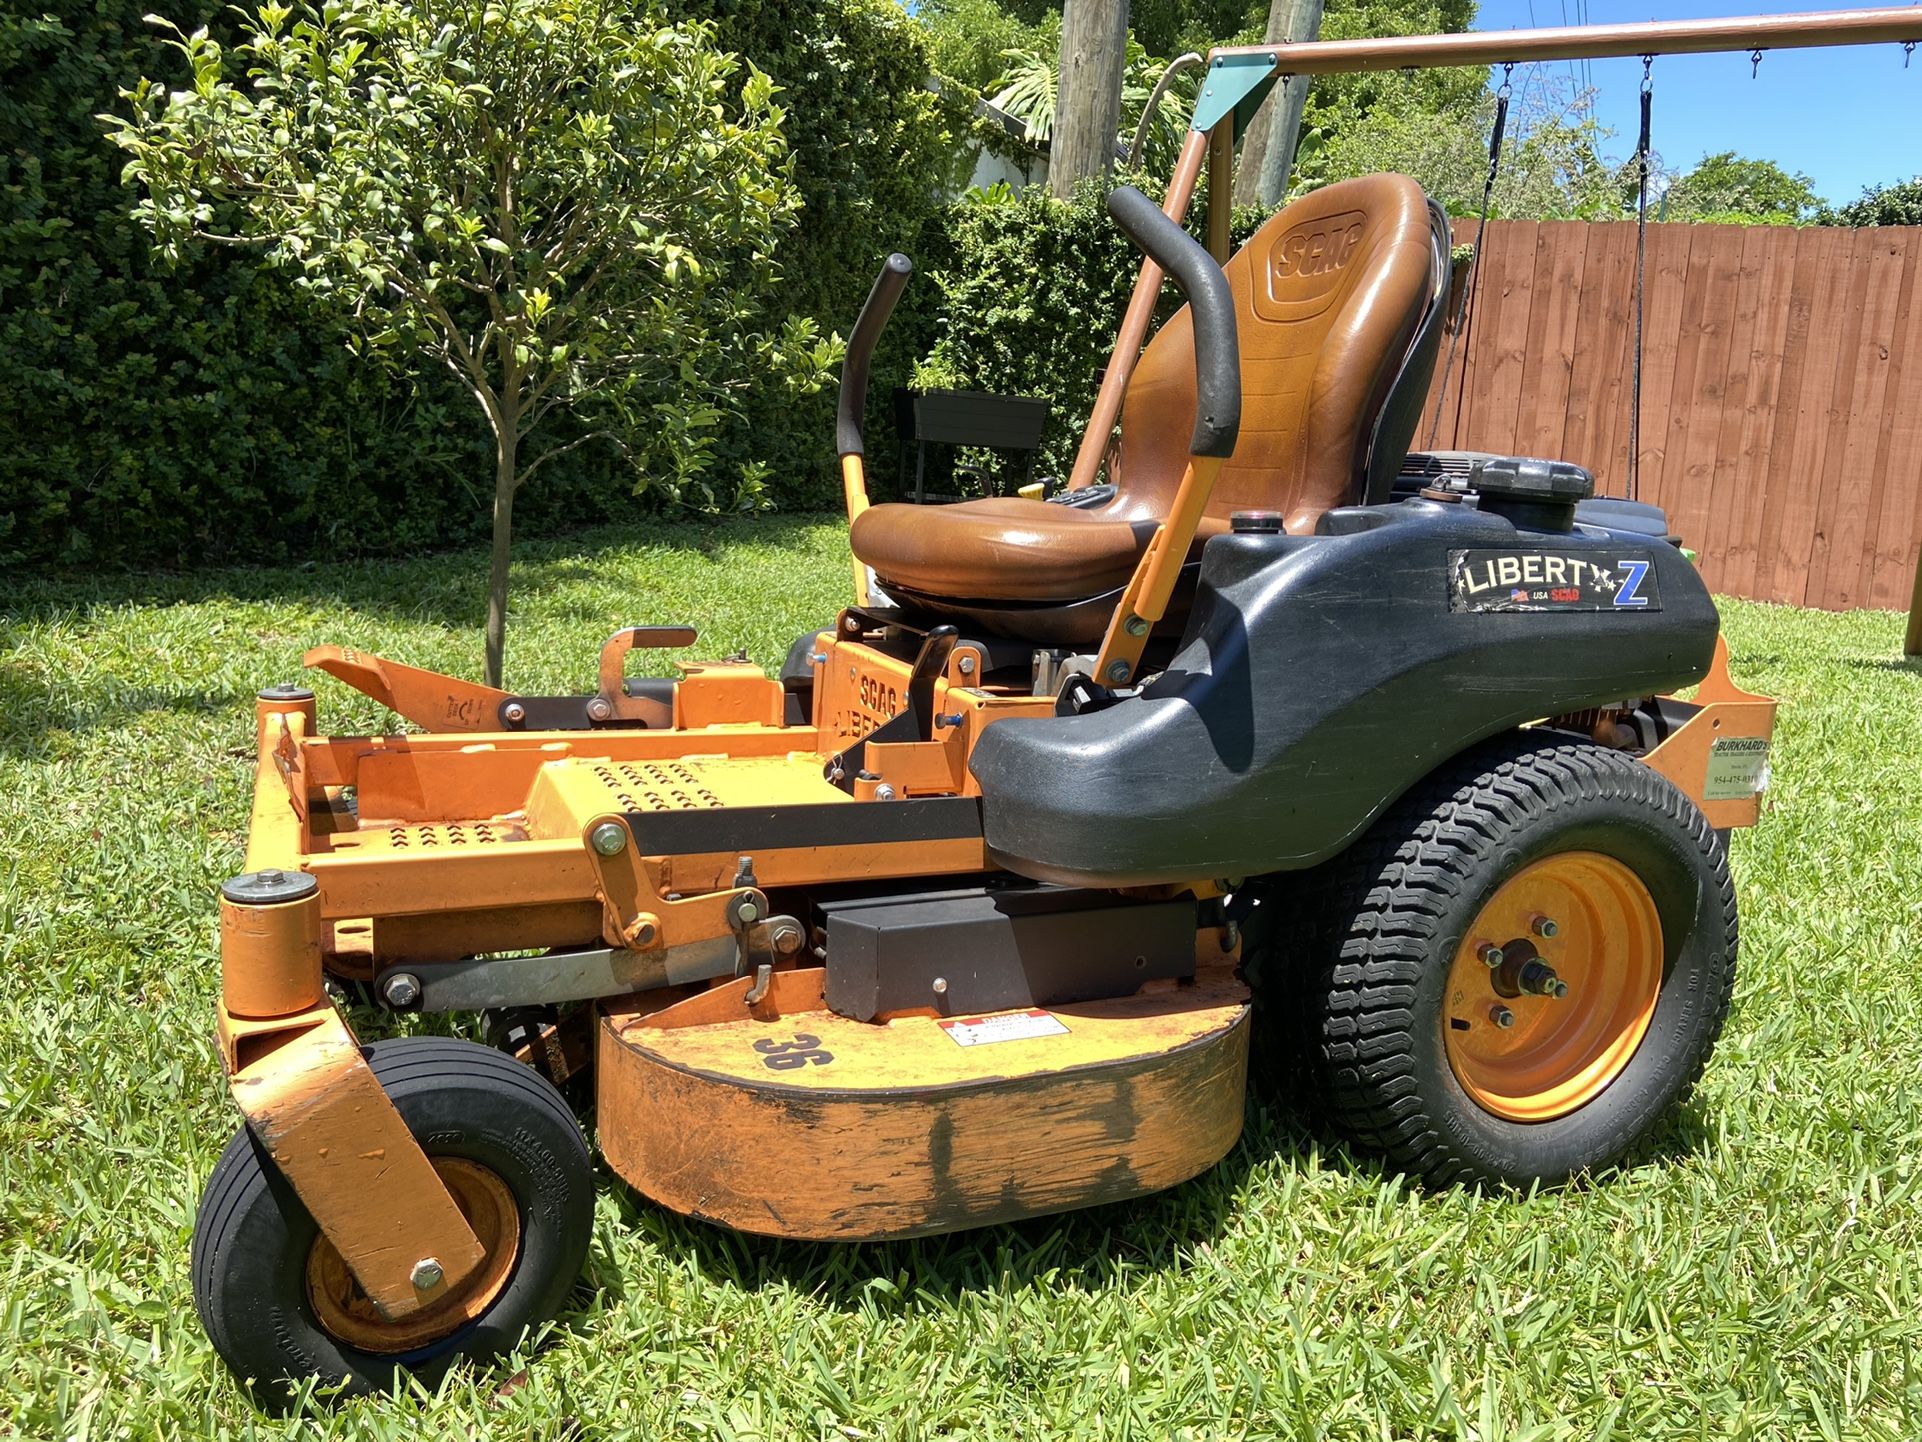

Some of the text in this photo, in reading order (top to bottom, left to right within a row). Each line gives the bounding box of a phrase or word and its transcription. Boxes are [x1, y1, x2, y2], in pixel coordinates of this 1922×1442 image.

[1275, 222, 1362, 279] SCAG
[1533, 591, 1549, 600] USA
[1613, 560, 1650, 606] Z
[860, 675, 897, 720] SCAG
[752, 1034, 835, 1071] 36
